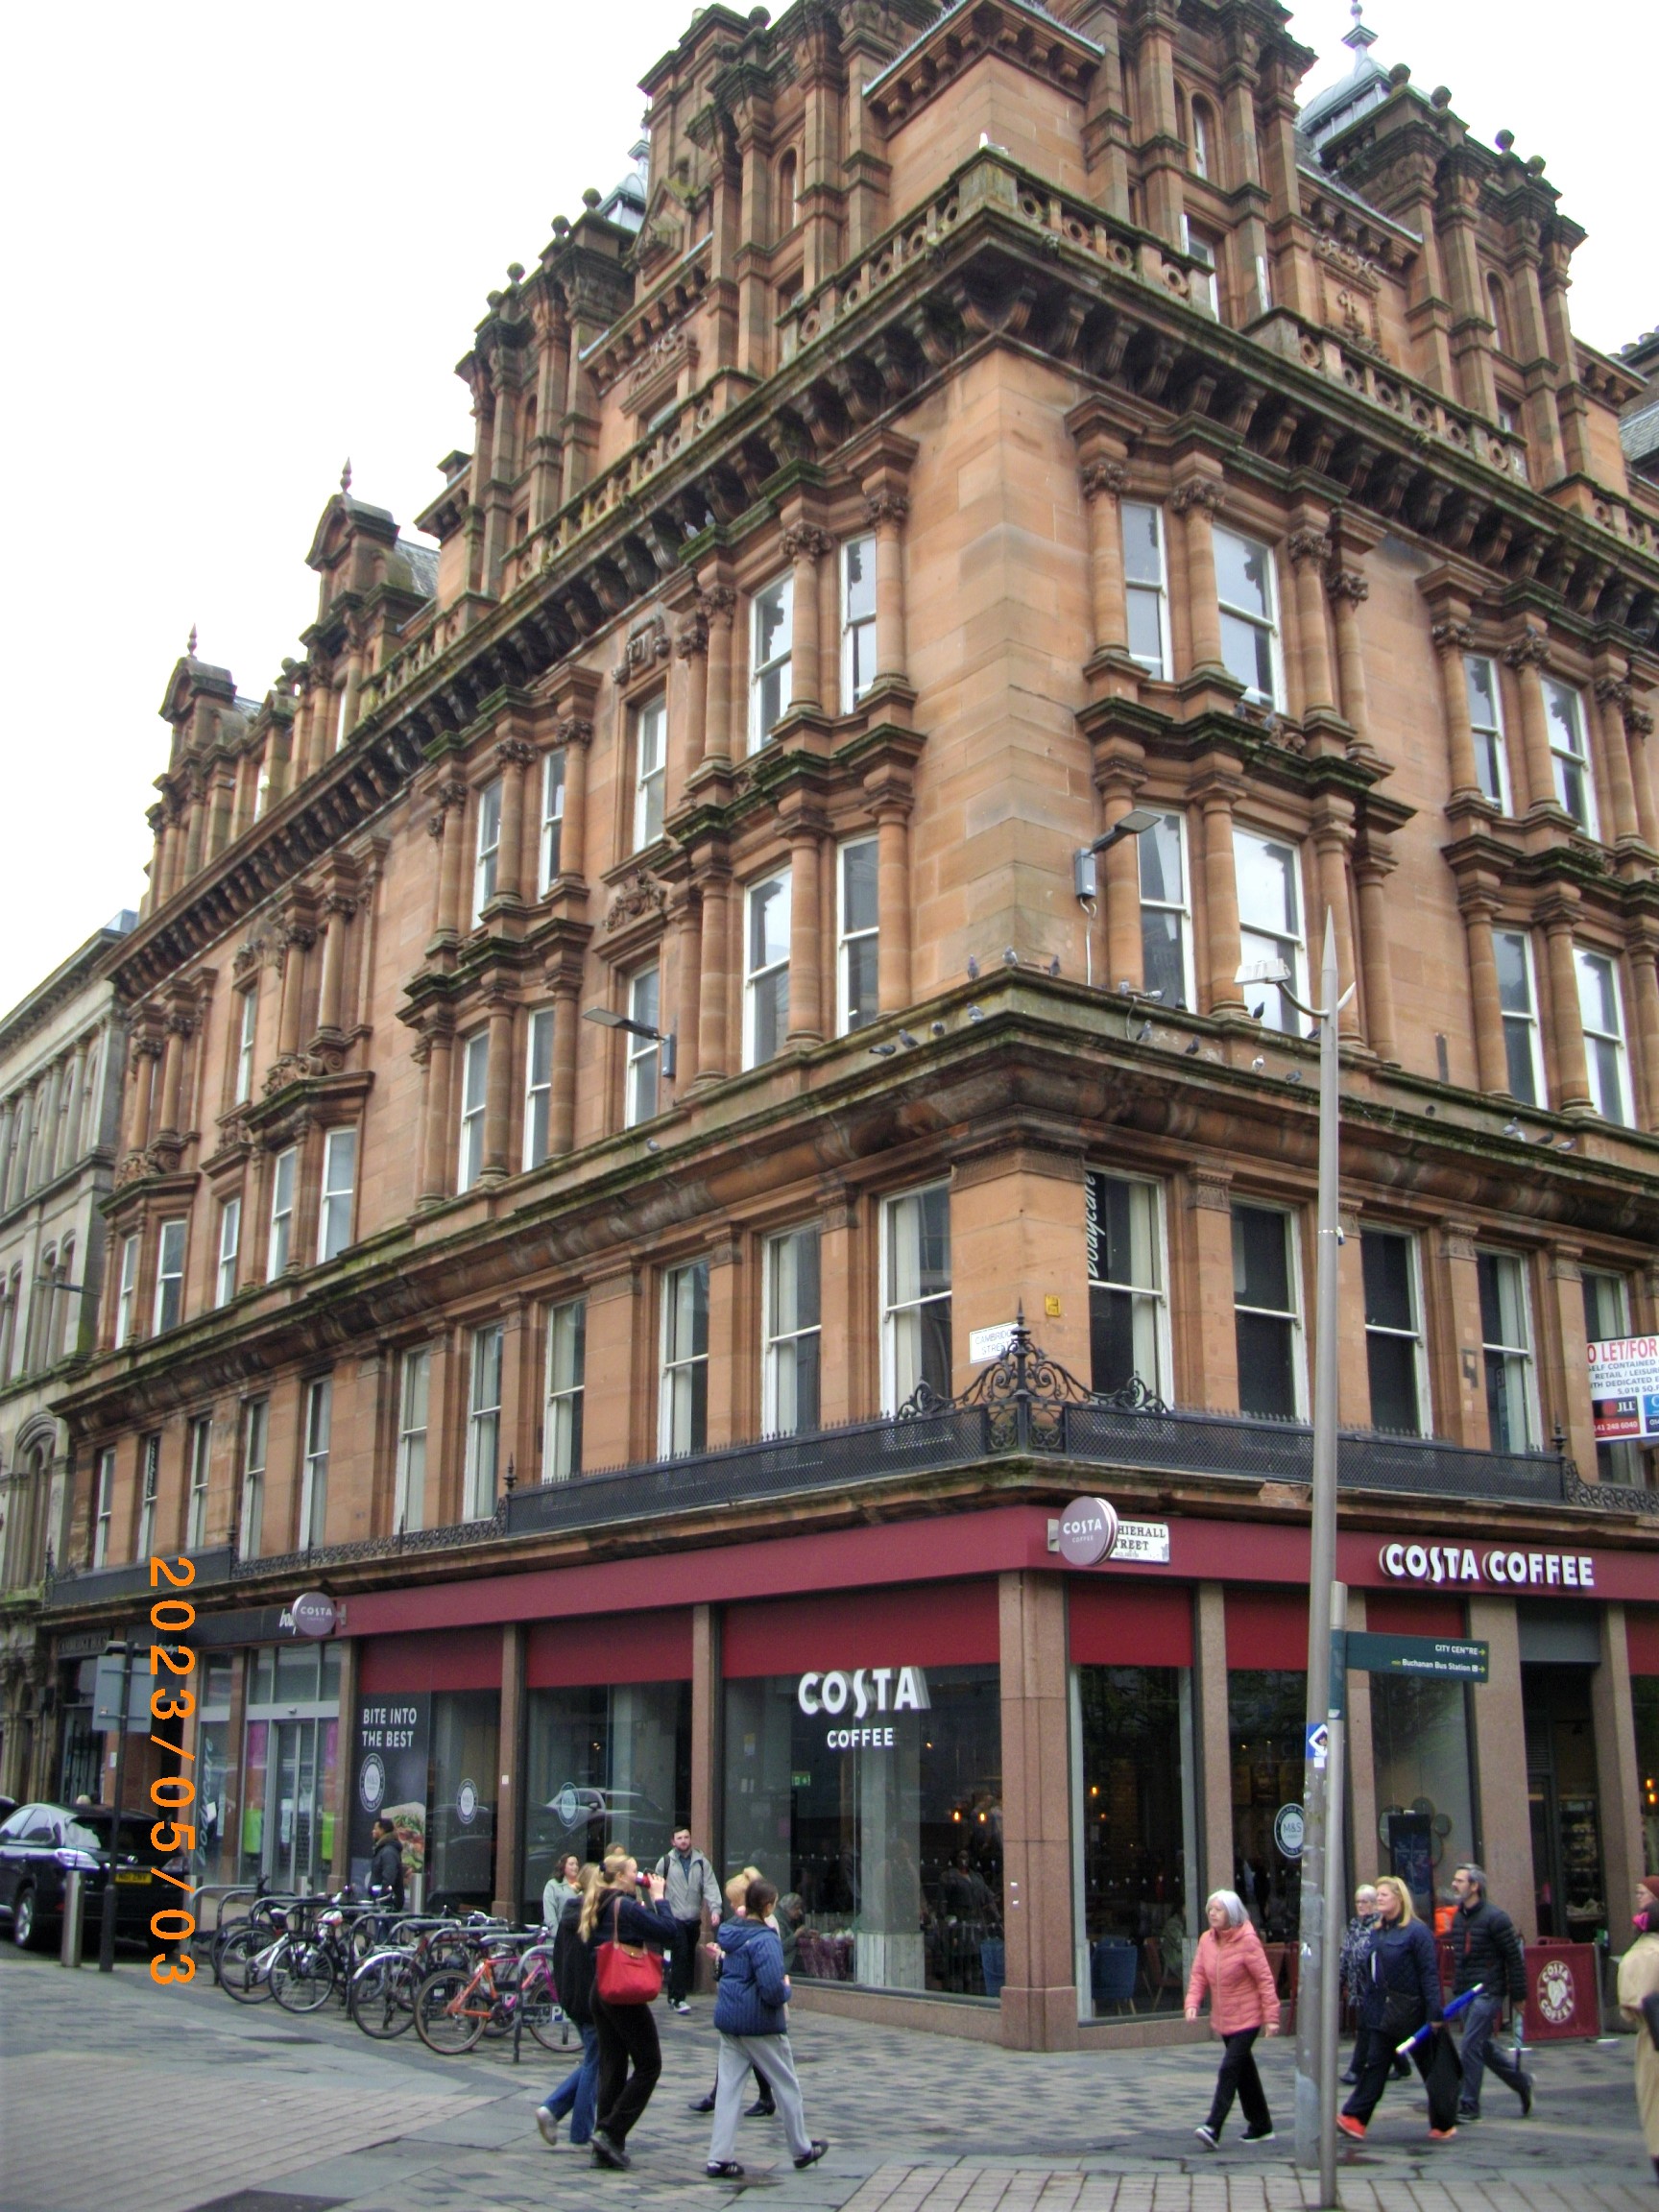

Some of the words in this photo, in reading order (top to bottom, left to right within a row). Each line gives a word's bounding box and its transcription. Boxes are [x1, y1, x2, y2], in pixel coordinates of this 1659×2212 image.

[1608, 1358, 1656, 1370] CONTAINED
[1590, 1381, 1603, 1389] ITH
[1606, 1376, 1652, 1387] DEDICATED
[1595, 1371, 1623, 1380] RETAIL
[1063, 1519, 1102, 1535] COSTA
[1380, 1543, 1479, 1583] COSTA
[1483, 1551, 1595, 1586] COFFEE
[301, 1606, 332, 1617] COSTA
[1435, 1644, 1450, 1652] CITY
[1452, 1646, 1479, 1655] CENTRE
[1402, 1659, 1433, 1669] Buchanan
[1435, 1661, 1447, 1670] Bus
[1449, 1663, 1471, 1671] Station
[798, 1666, 929, 1719] COSTA
[363, 1709, 386, 1724] BITE
[390, 1708, 417, 1724] INTO
[362, 1731, 382, 1746] THE
[386, 1731, 414, 1747] BEST
[828, 1728, 894, 1748] COFFEE
[1283, 1822, 1302, 1833] M&S
[1542, 1963, 1568, 1983] COSTA
[1541, 1999, 1574, 2020] COFFEE
